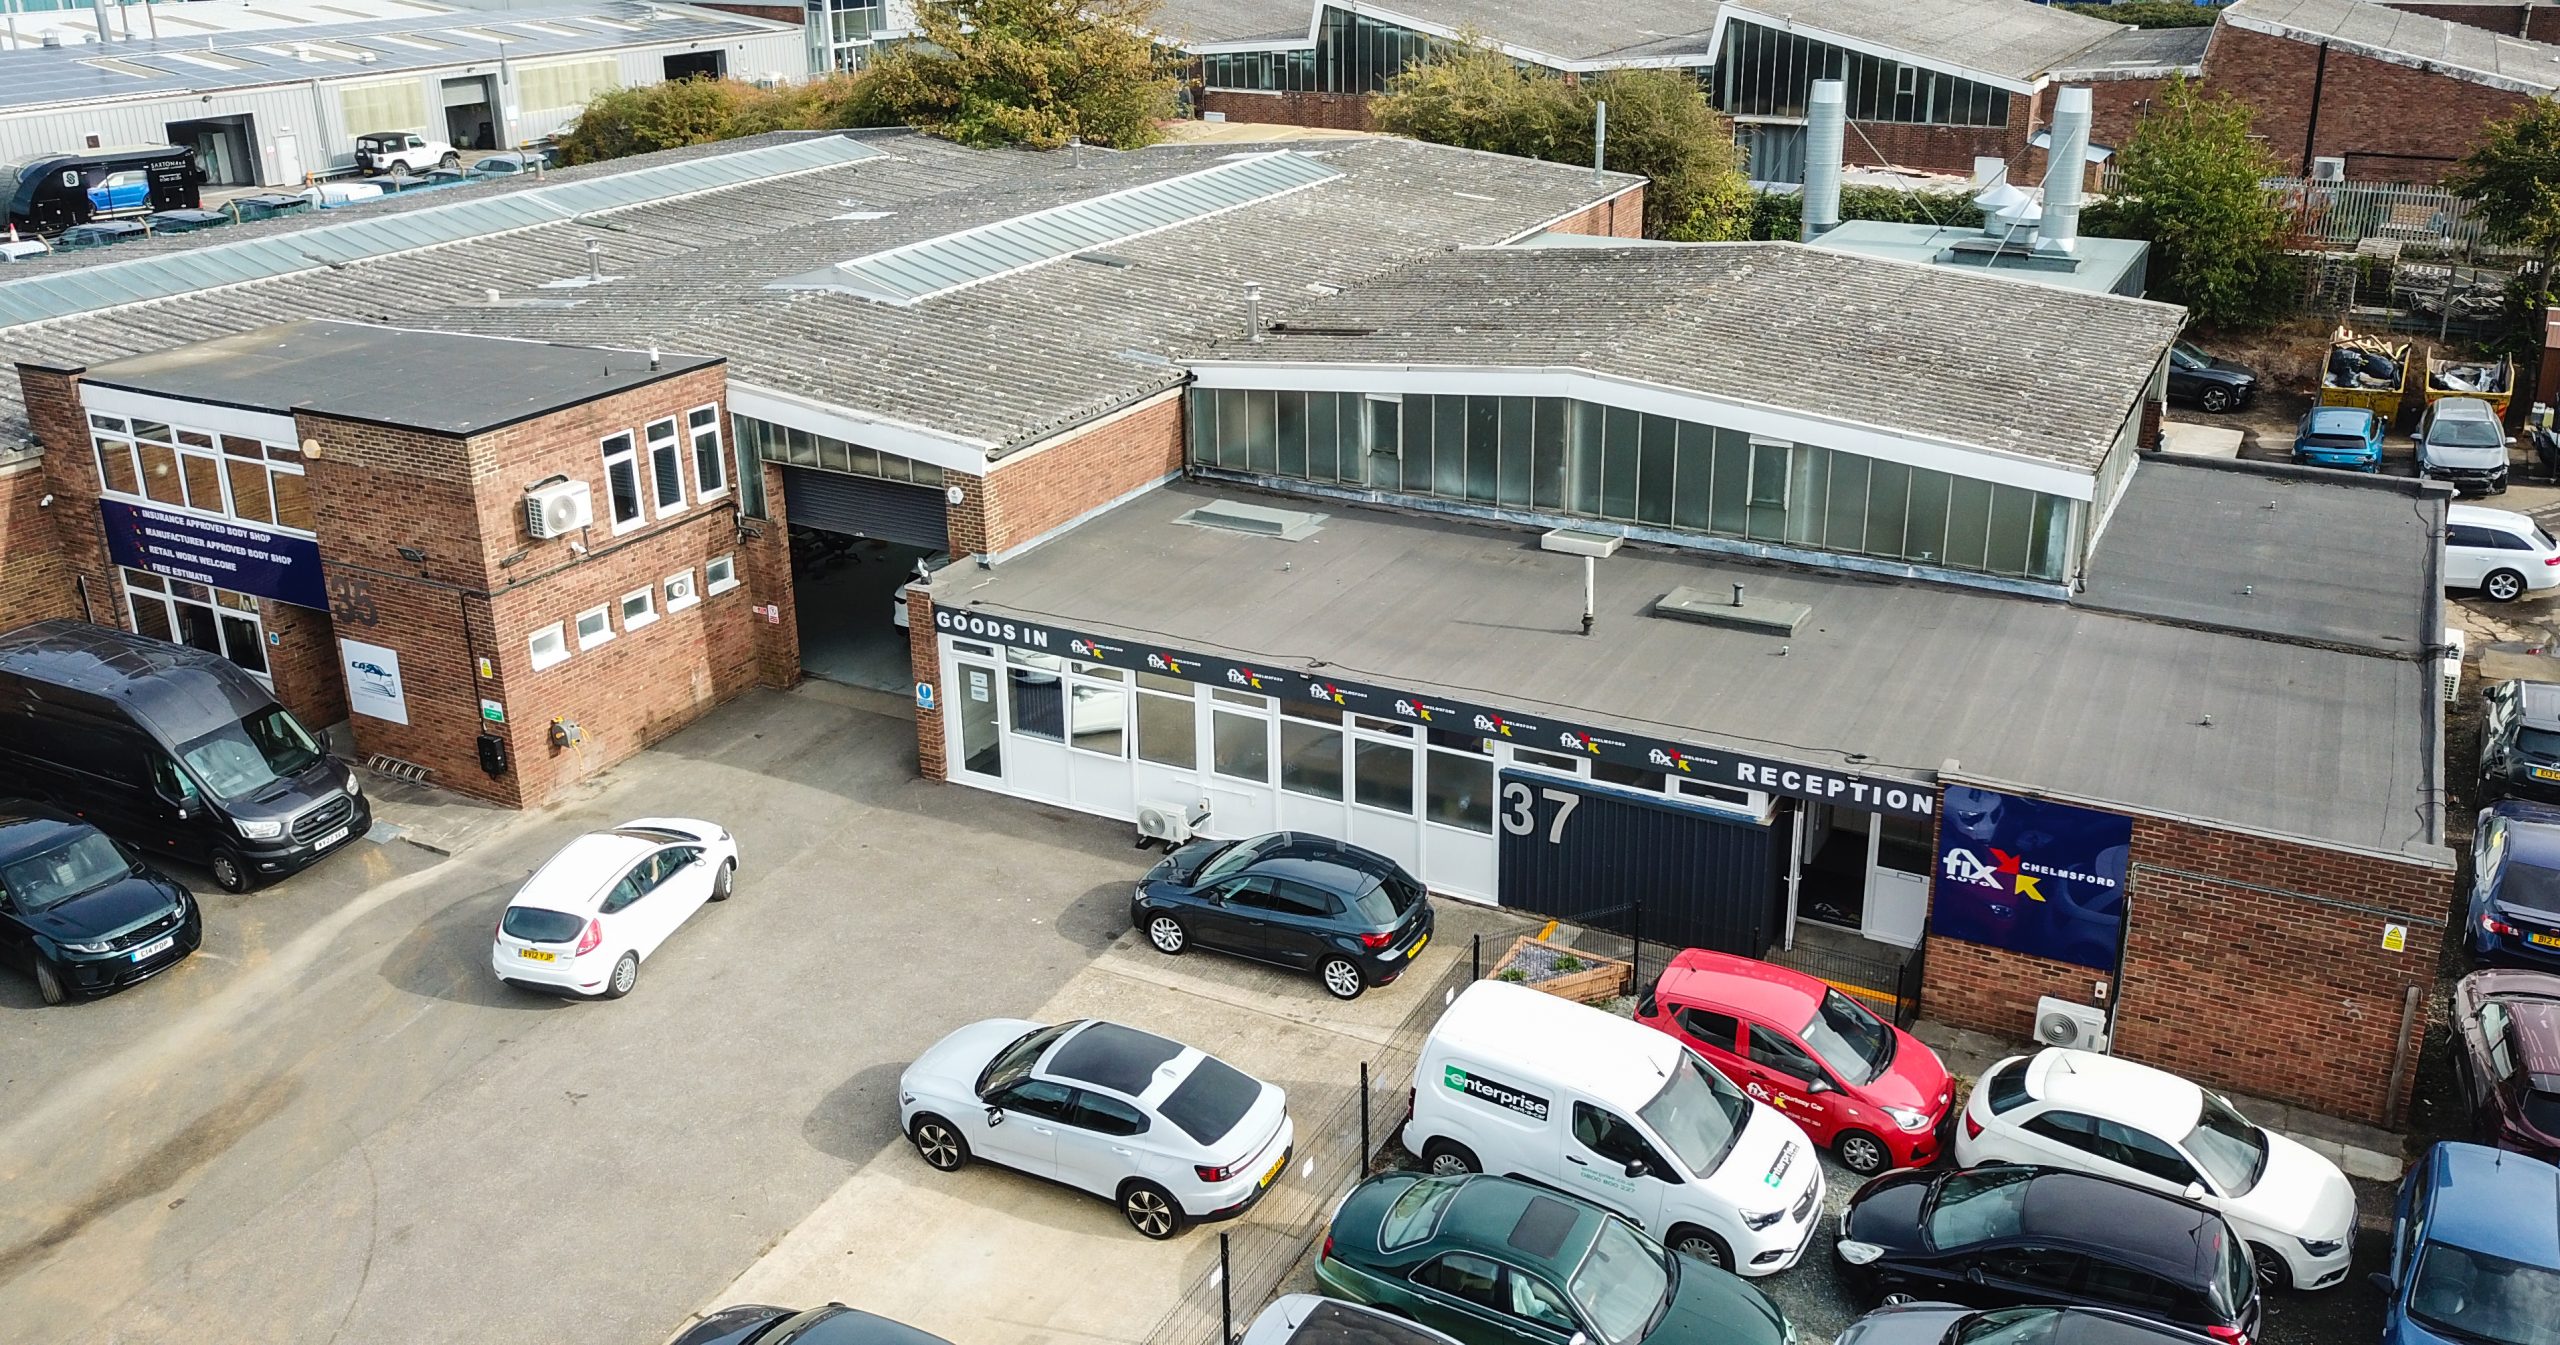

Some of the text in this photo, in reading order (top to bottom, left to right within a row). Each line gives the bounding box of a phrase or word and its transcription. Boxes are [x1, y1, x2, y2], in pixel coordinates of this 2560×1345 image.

[141, 509, 271, 543] INSURANCE APPROVED BODY SHOP
[145, 527, 292, 566] MANUFACTURER APPROVED BODY SHOP
[148, 545, 237, 572] RETAIL WORK WELCOME
[152, 563, 214, 584] FREE ESTIMATES
[936, 611, 1048, 648] GOODS IN
[1737, 762, 1934, 815] RECEPTION
[1501, 782, 1580, 844] 37
[1942, 847, 2116, 890] fix CHELMSFORD
[1945, 875, 1991, 887] AUTO
[1449, 1073, 1547, 1115] enterprise
[1778, 1091, 1824, 1112] Courtesy Car
[1509, 1104, 1545, 1119] rent-a-car
[1580, 1172, 1602, 1183] 0800
[1603, 1179, 1619, 1188] 800
